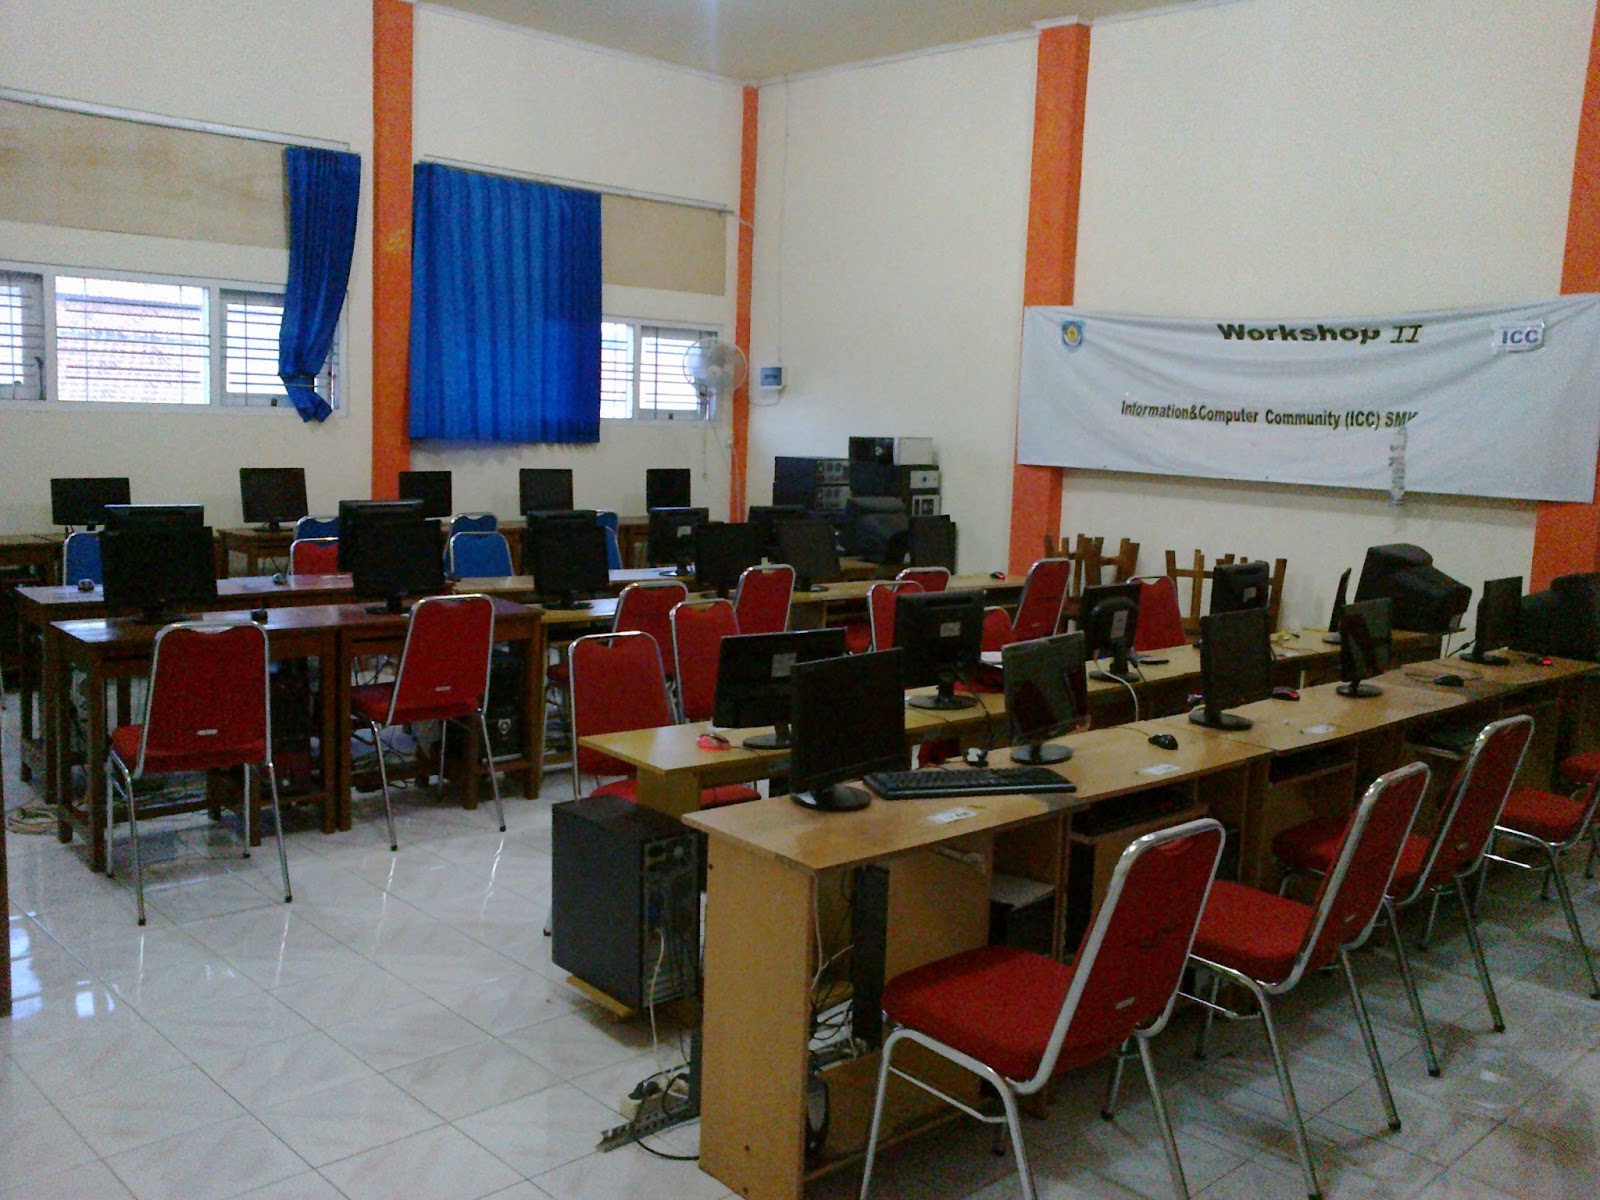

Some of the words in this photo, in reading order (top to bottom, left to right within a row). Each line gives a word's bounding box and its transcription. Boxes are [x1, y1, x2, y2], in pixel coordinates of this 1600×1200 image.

[1217, 323, 1380, 345] Workshop
[1390, 324, 1423, 344] II
[1501, 329, 1539, 345] ICC
[1265, 409, 1341, 431] Community
[1345, 410, 1380, 431] (ICC)
